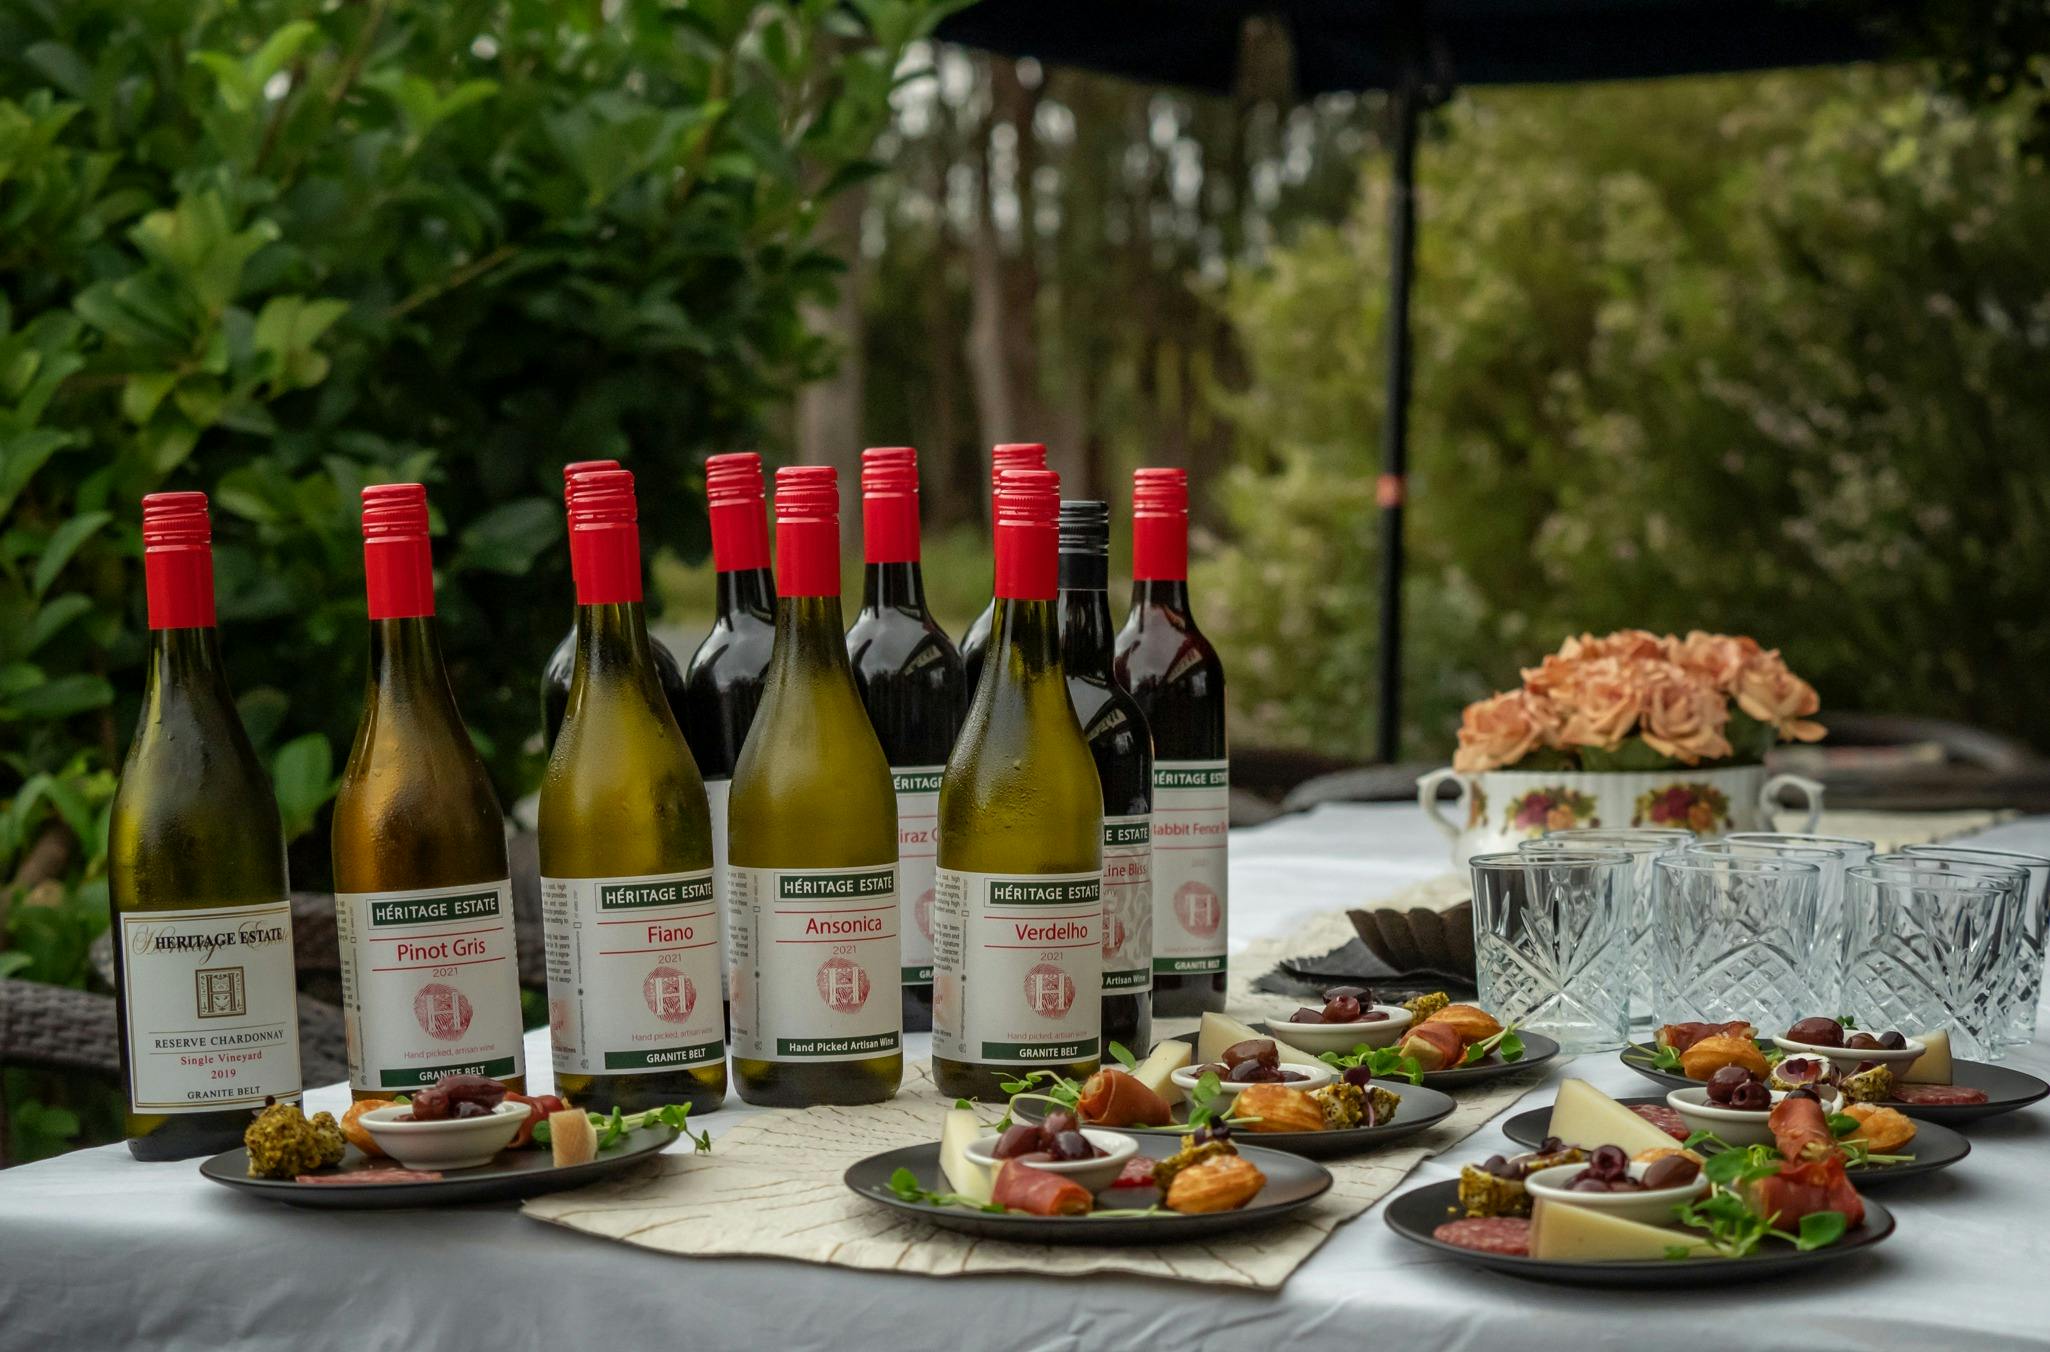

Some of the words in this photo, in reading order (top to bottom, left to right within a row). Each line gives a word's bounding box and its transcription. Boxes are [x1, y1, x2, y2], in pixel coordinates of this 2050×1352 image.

[894, 776, 943, 790] ÉRITAGE
[900, 828, 928, 843] iraz
[1118, 828, 1148, 841] ESTATE
[1154, 823, 1190, 835] abbit
[1104, 864, 1126, 877] ine
[1128, 863, 1146, 876] Bliss
[784, 878, 854, 894] HÉRITAGE
[860, 876, 893, 891] ESTATE
[994, 885, 1063, 900] HÉRITAGE
[1068, 884, 1099, 899] ESTATE
[606, 888, 676, 904] HÉRITAGE
[682, 882, 713, 898] ESTATE
[376, 902, 448, 921] HÉRITAGE
[454, 898, 496, 915] ESTATE
[806, 916, 882, 934] Ansonica
[155, 932, 235, 950] HERITAGE
[240, 927, 282, 944] ESTATE
[647, 925, 694, 943] Fiano
[1015, 924, 1088, 941] Verdelho
[397, 942, 448, 962] Pinot
[453, 938, 486, 957] Gris
[832, 945, 857, 955] 2021
[1040, 951, 1064, 961] 2021
[658, 954, 682, 964] 2021
[433, 967, 458, 978] 2021
[1106, 976, 1132, 985] Artisan
[155, 1037, 206, 1049] RESERVE
[211, 1030, 284, 1046] CHARDONNAY
[632, 1032, 652, 1041] Hand
[1007, 1032, 1026, 1040] Hand
[789, 1042, 814, 1052] Hand
[817, 1041, 848, 1052] Picked
[850, 1040, 878, 1050] Artisan
[879, 1037, 894, 1047] Wine
[181, 1055, 214, 1067] Single
[218, 1051, 262, 1063] Vineyard
[405, 1050, 424, 1059] Hand
[455, 1045, 479, 1055] artisan
[646, 1050, 687, 1063] GRANITE
[689, 1048, 706, 1059] BELT
[1020, 1047, 1059, 1058] GRANITE
[1061, 1046, 1078, 1056] BELT
[211, 1069, 237, 1079] 2019
[187, 1088, 234, 1100] GRANITE
[238, 1086, 261, 1096] BELT
